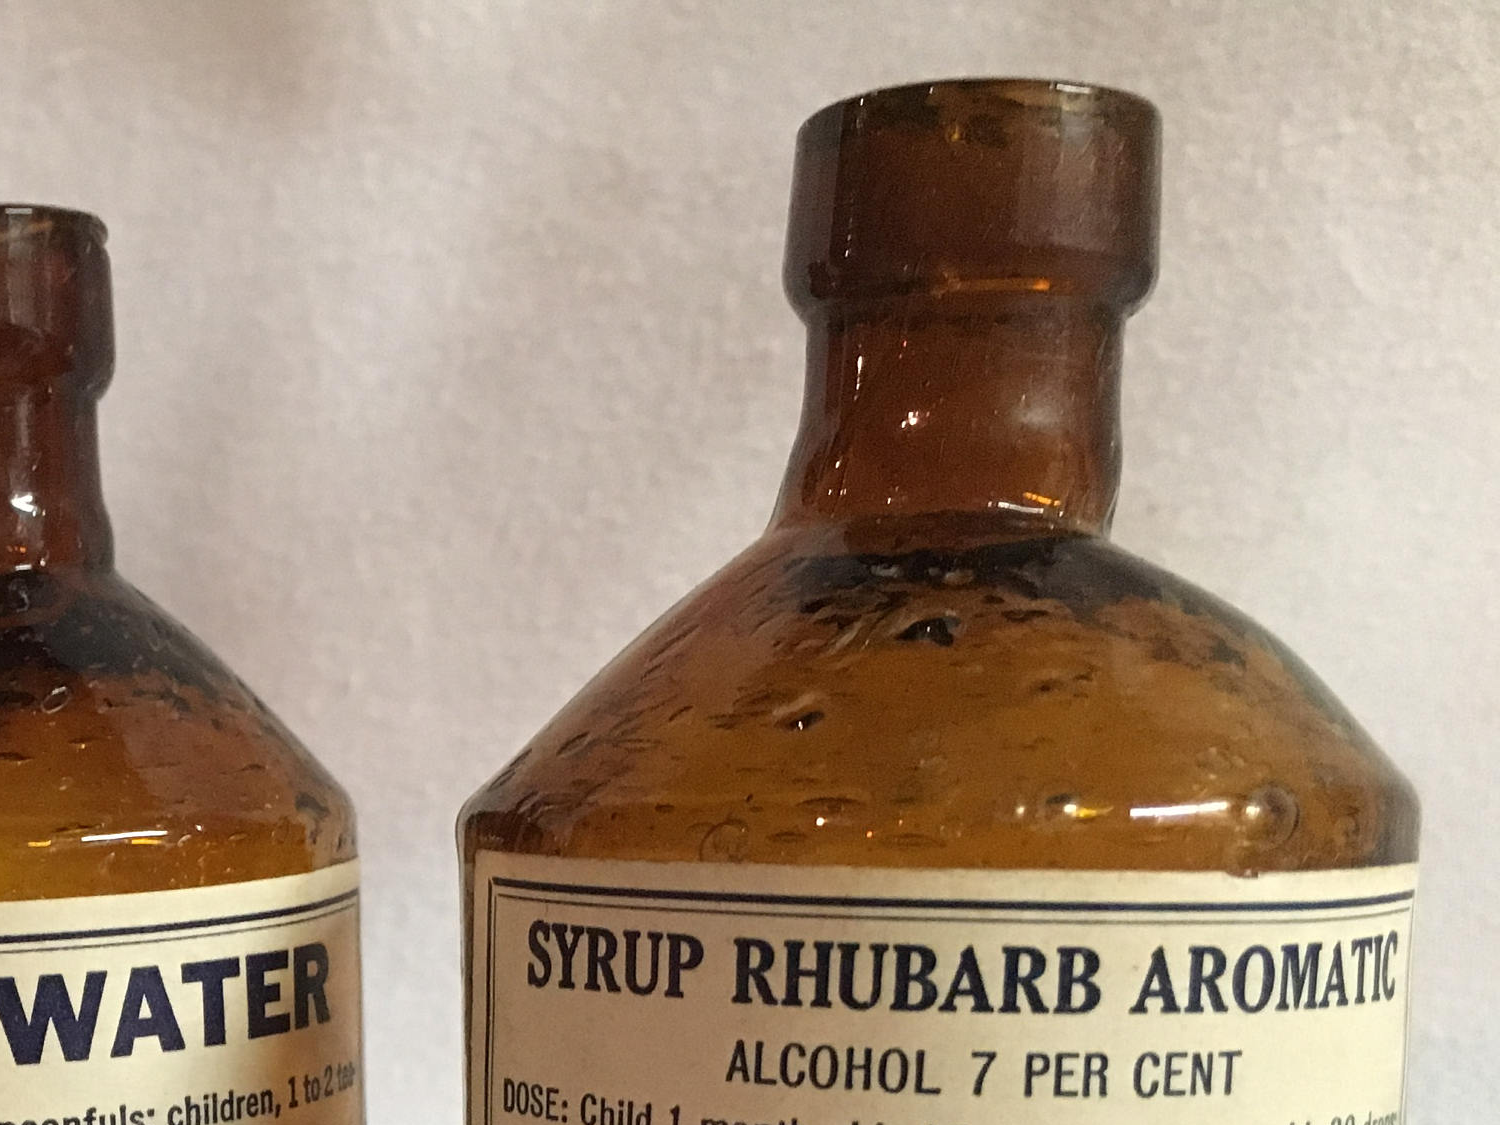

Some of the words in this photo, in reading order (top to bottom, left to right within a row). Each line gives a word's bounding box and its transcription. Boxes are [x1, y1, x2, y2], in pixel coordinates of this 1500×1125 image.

[527, 919, 705, 999] SYRUP
[731, 937, 1102, 1014] RHUBARB
[1128, 929, 1399, 1015] AROMATIC
[287, 1075, 299, 1109] 1
[303, 1073, 321, 1104] to
[323, 1064, 334, 1098] 2
[725, 1039, 943, 1096] ALCOHOL
[971, 1051, 998, 1096] 7
[1023, 1052, 1109, 1098] PER
[1132, 1049, 1244, 1099] CENT
[503, 1077, 570, 1124] DOSE:
